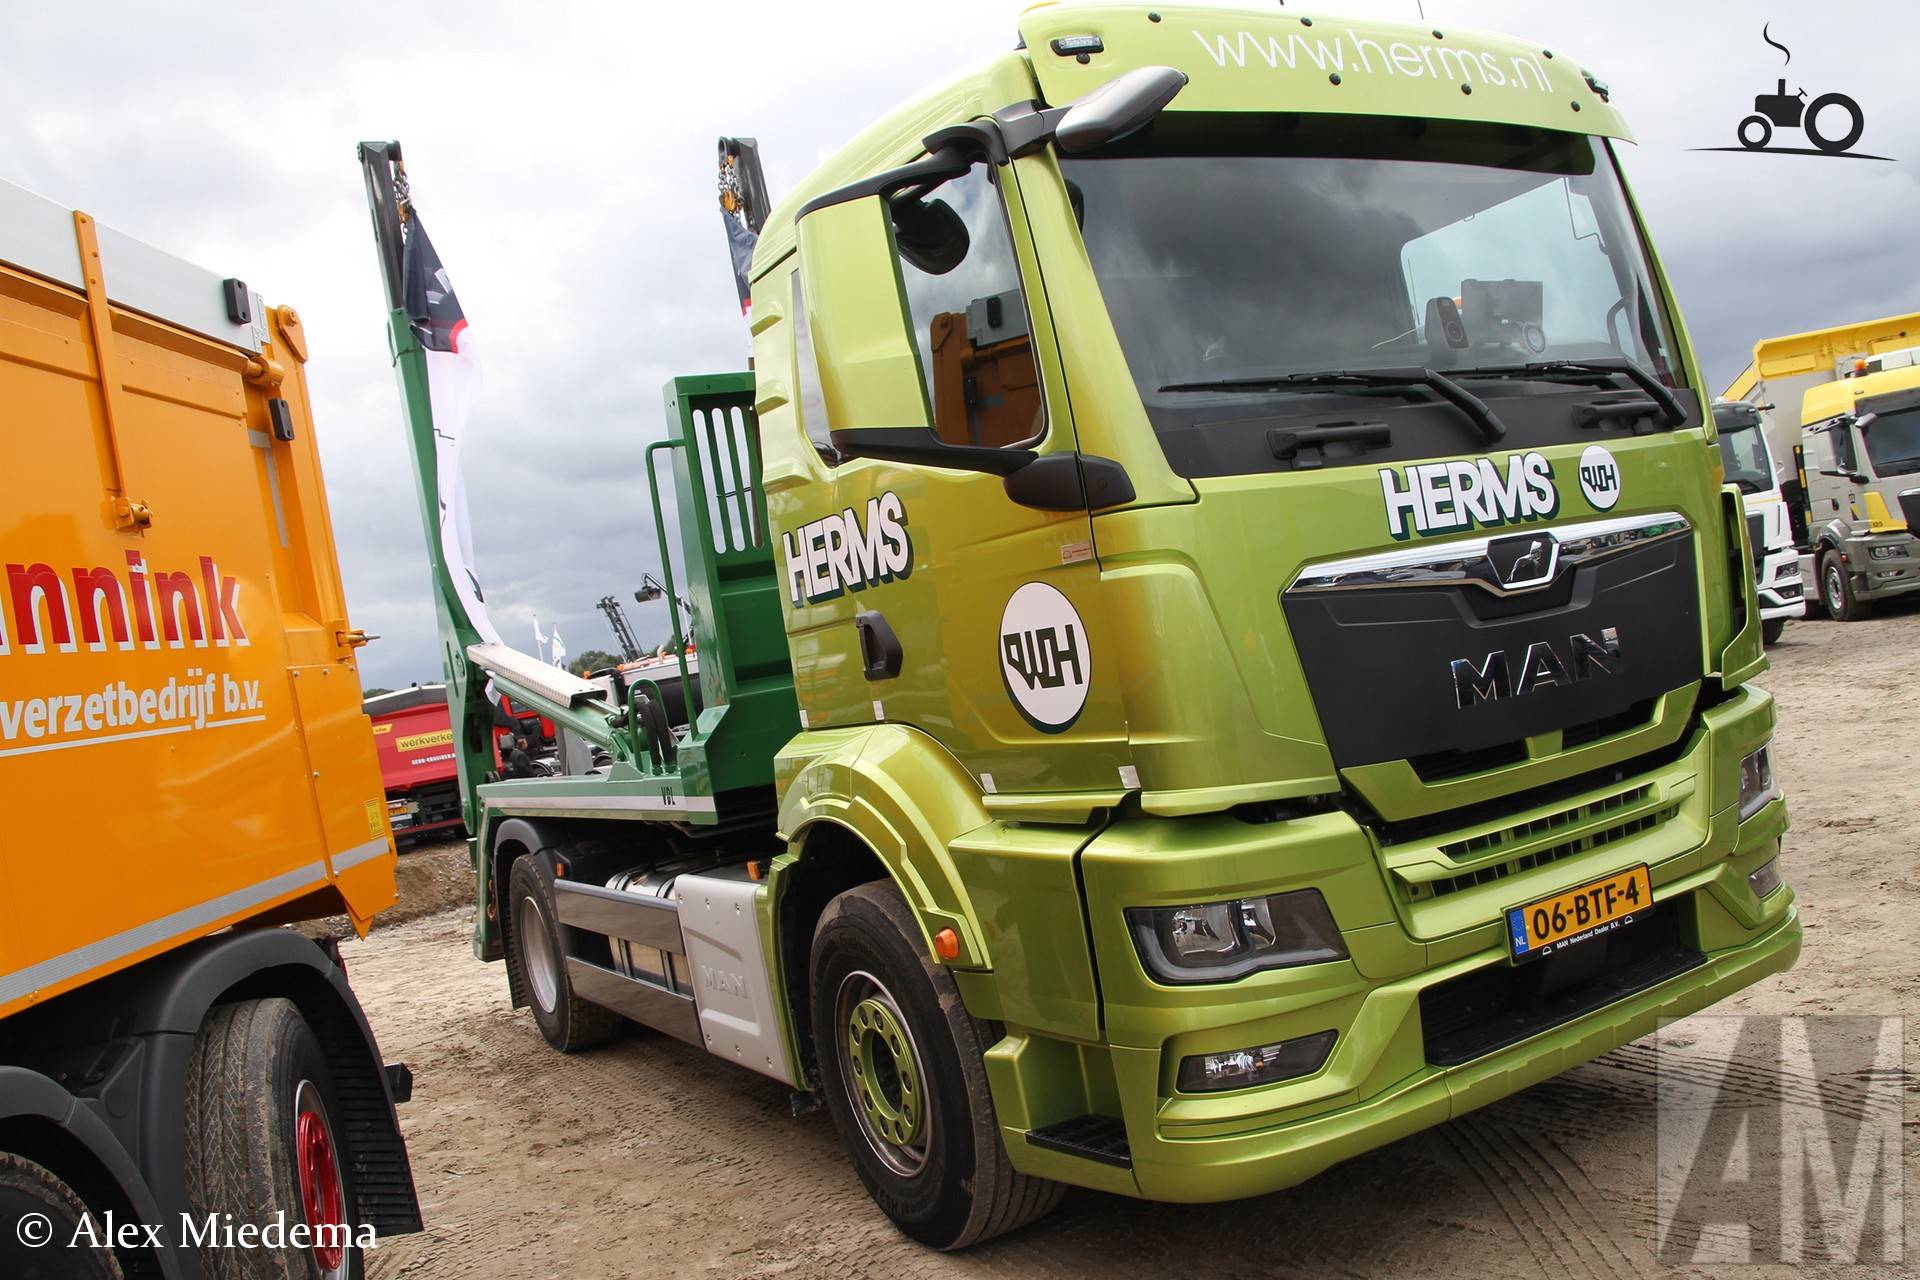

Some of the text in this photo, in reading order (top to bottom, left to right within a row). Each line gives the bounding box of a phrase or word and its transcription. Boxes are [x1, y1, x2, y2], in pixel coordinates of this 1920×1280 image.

[1192, 29, 1553, 93] www.herms.nl
[1379, 452, 1560, 540] HERMS
[782, 491, 914, 608] HERMS
[0, 549, 251, 656] nnink
[1451, 627, 1623, 709] MAN
[0, 668, 263, 740] verzetbedrijf b.v.
[661, 786, 675, 805] VDL
[1515, 876, 1640, 947] NL 06-BTF-4
[1557, 940, 1569, 949] MAN
[1570, 930, 1594, 944] Nederland
[1595, 924, 1609, 935] Dealer
[701, 965, 748, 999] MAN
